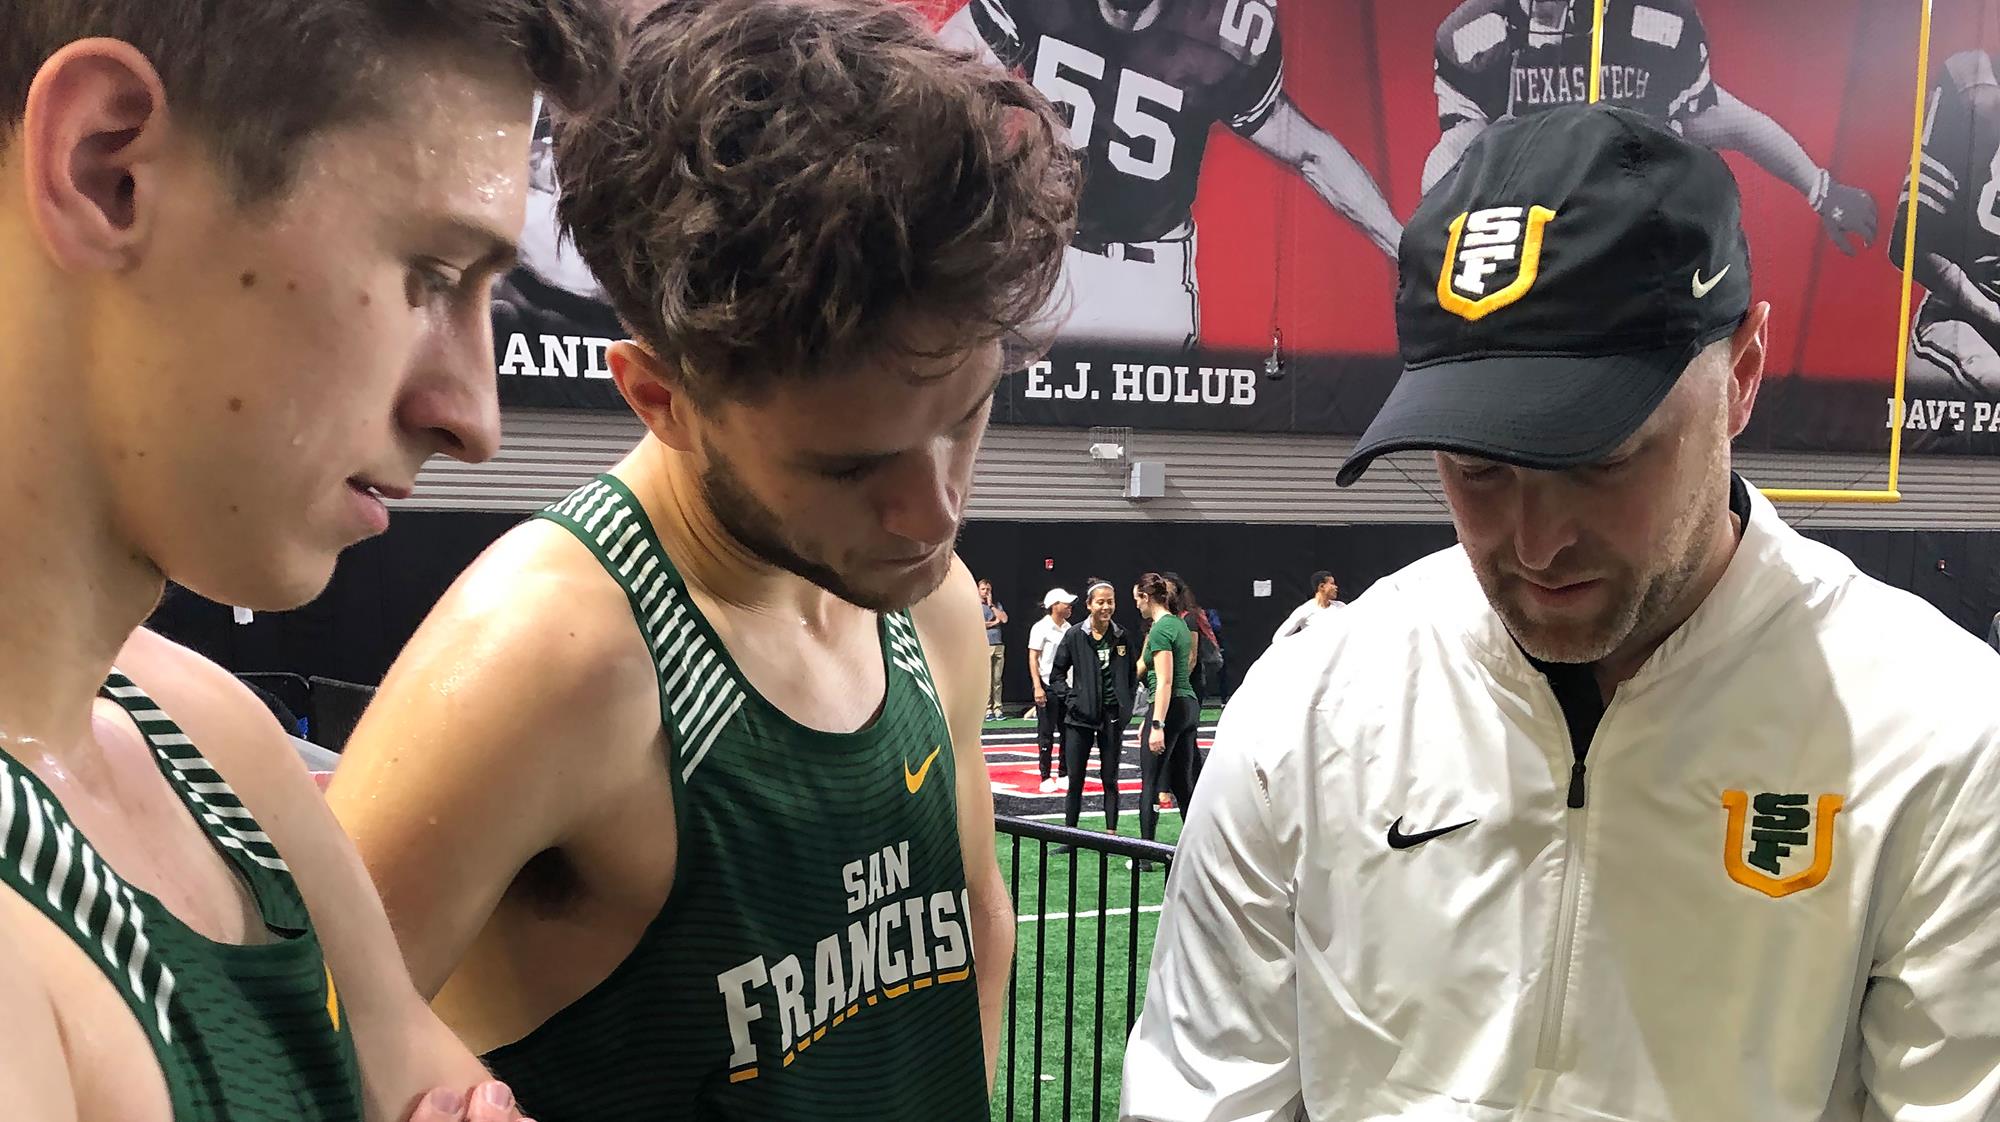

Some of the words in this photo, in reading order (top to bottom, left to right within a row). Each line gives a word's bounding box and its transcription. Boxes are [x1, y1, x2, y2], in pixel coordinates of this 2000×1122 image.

[1032, 34, 1184, 181] 55
[1515, 66, 1586, 104] TEXAS
[1600, 65, 1650, 100] TECH
[499, 333, 637, 378] AND
[1025, 361, 1099, 399] E.J.
[1112, 363, 1256, 405] HOLUB
[842, 840, 910, 914] SAN
[716, 888, 976, 1069] FRANCIS
